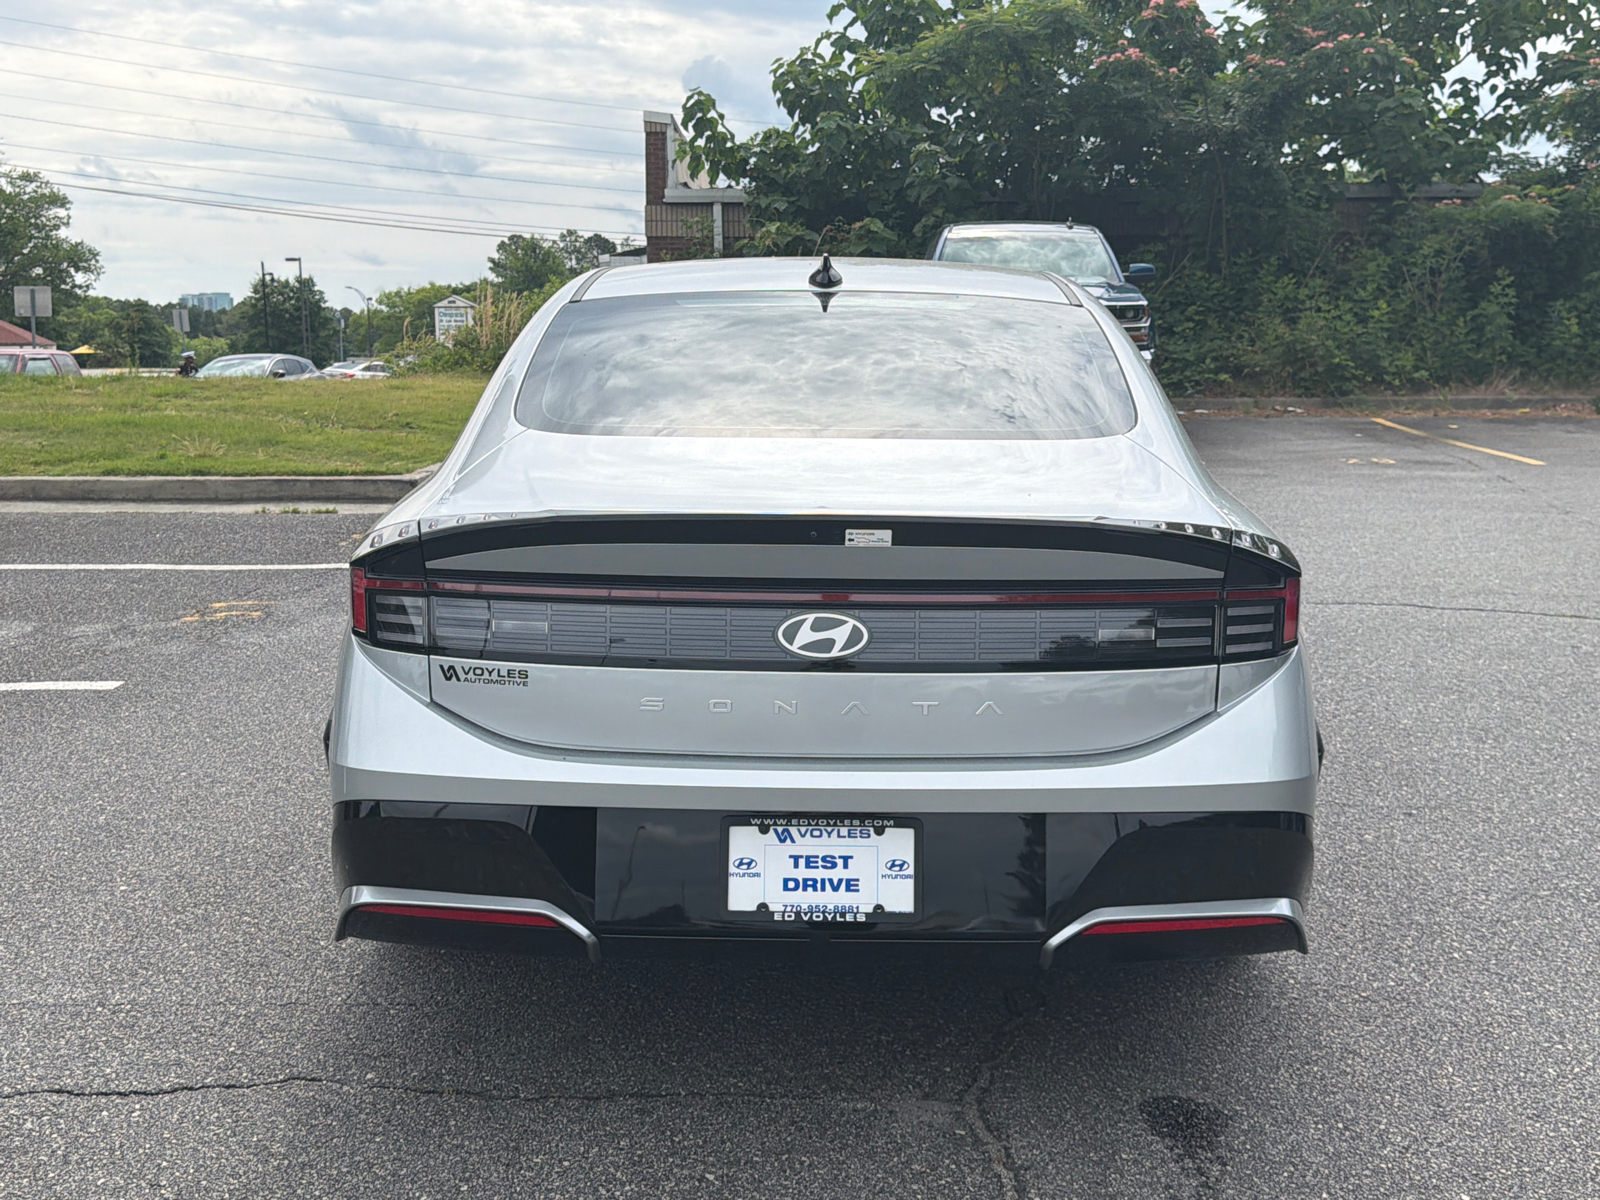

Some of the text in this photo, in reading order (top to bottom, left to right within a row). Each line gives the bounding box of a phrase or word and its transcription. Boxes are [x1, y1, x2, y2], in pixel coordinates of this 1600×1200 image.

[461, 666, 529, 680] VOYLES
[463, 677, 529, 687] AUTOMOTIVE
[639, 697, 1003, 716] SONATA
[750, 818, 895, 827] WWW.EDVOYLES.COM
[797, 828, 871, 839] VOYLES
[788, 855, 854, 870] TEST
[782, 878, 860, 893] DRIVE
[782, 904, 860, 913] 770-952-8881
[773, 912, 867, 922] ED VOYLES
